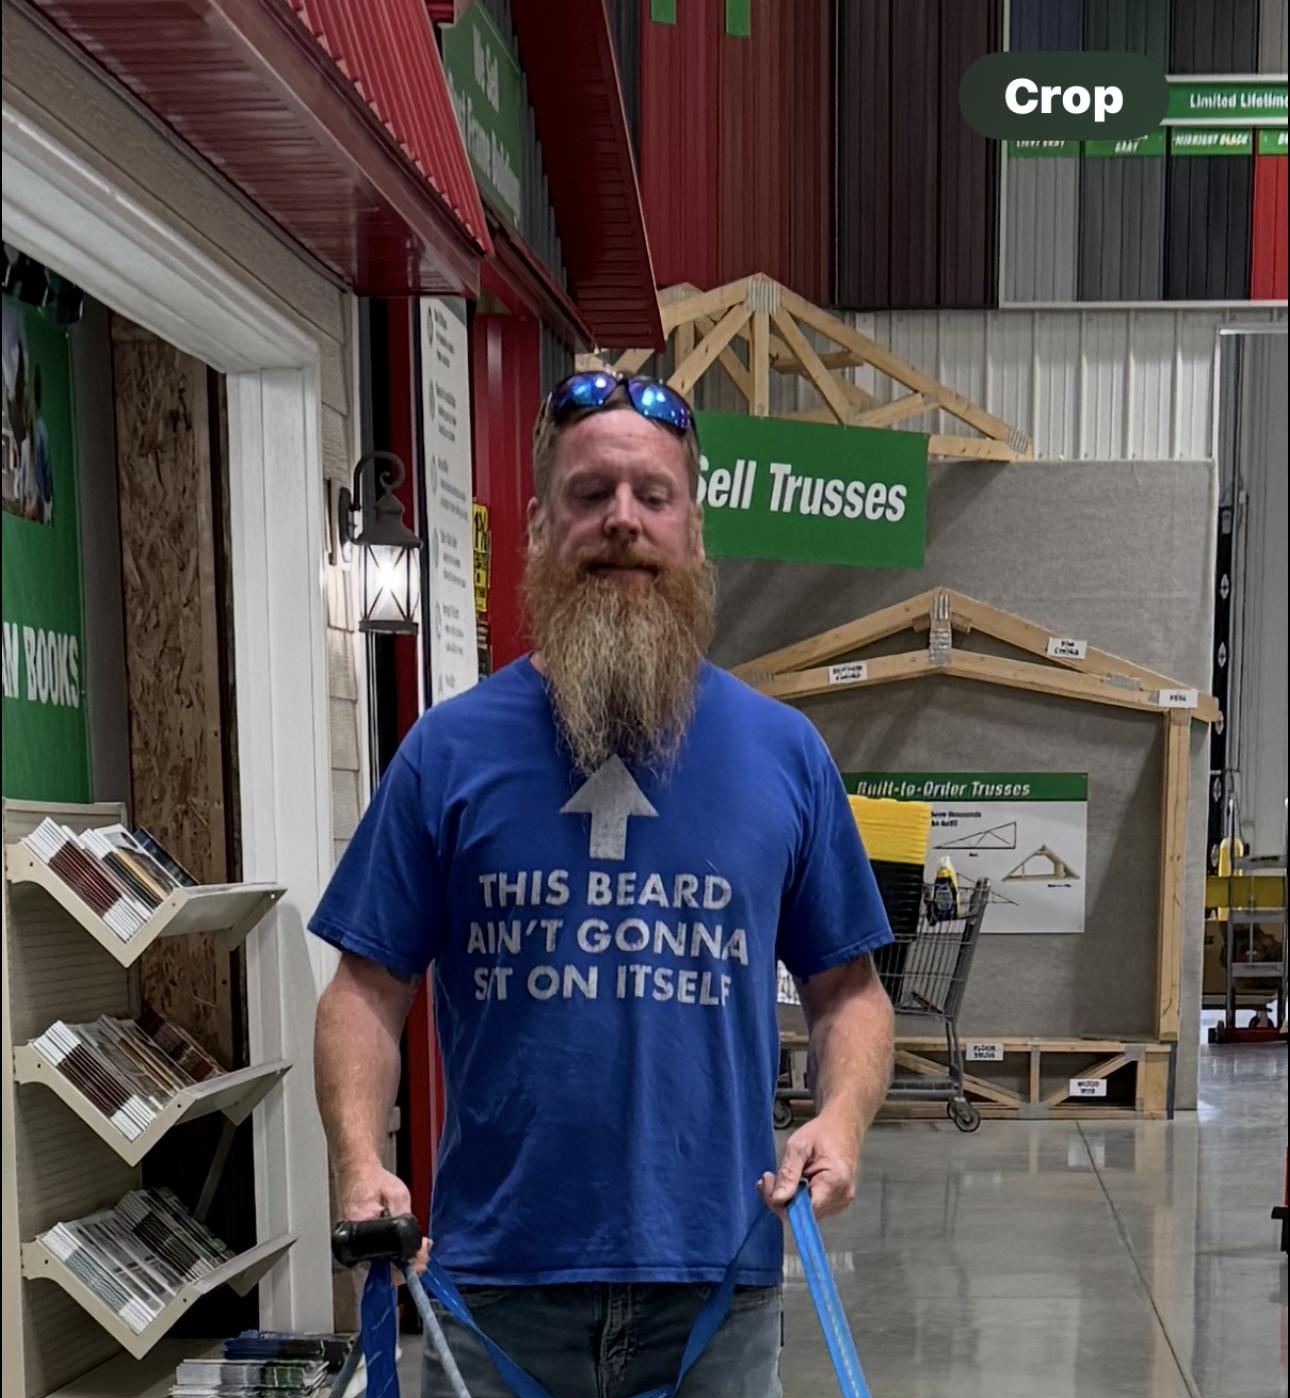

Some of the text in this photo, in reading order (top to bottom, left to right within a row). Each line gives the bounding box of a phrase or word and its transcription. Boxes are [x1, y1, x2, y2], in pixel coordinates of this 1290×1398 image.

[1189, 92, 1236, 109] Limited
[769, 462, 908, 523] Trusses
[22, 625, 80, 709] BOOKS
[857, 780, 1032, 798] Built-to-Order Trusses
[478, 868, 733, 911] THIS BEARD
[467, 917, 749, 966] AIN'T GONNA
[526, 964, 599, 1001] ON
[616, 964, 732, 1007] ITSELF
